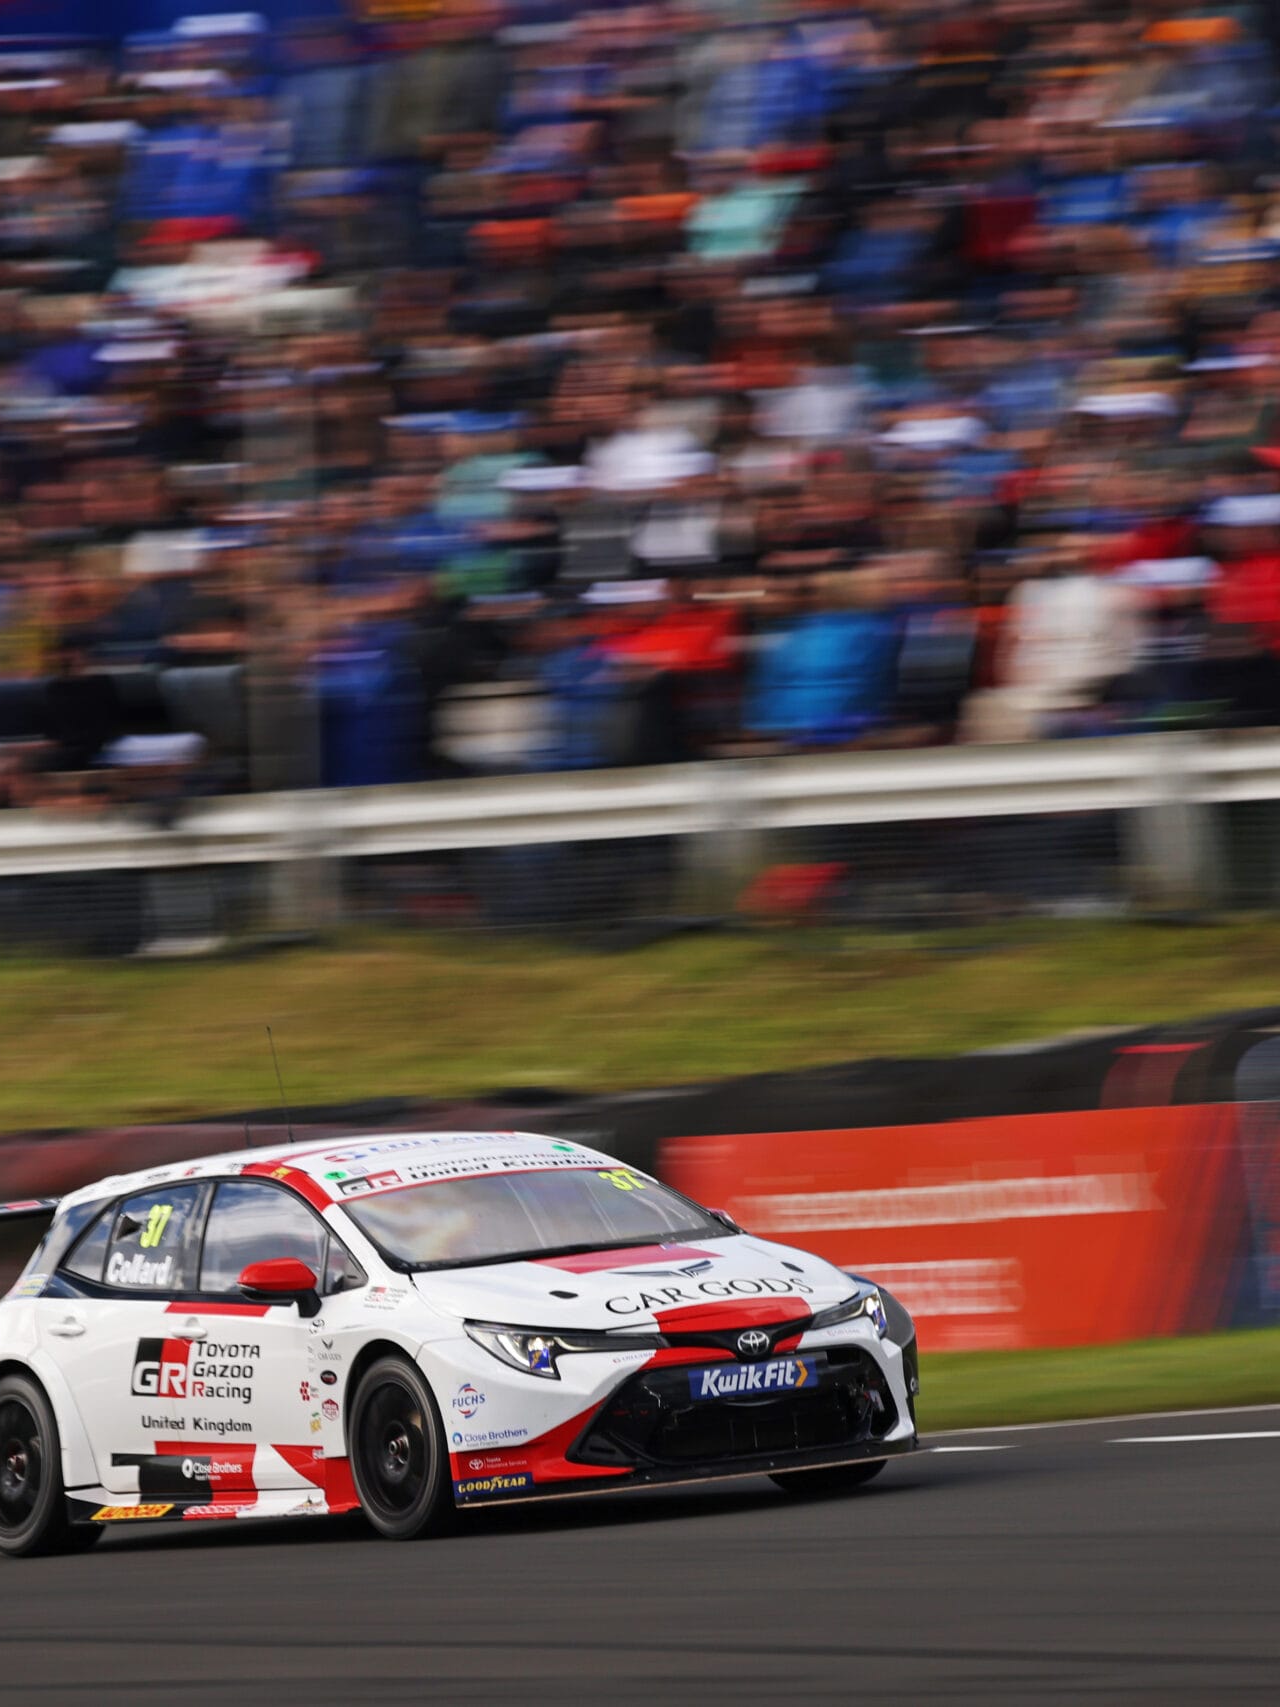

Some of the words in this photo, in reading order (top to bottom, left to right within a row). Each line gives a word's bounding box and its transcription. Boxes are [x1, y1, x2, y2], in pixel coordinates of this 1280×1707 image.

[410, 1162, 490, 1180] United
[501, 1158, 604, 1168] Kingdom
[597, 1169, 646, 1191] 37
[140, 1204, 174, 1248] 37
[107, 1252, 173, 1285] Collard
[605, 1287, 700, 1315] CAR
[698, 1277, 814, 1297] GODS
[195, 1340, 261, 1358] TOYOTA
[132, 1361, 186, 1396] GR
[192, 1361, 254, 1379] GAZOO
[192, 1381, 252, 1404] Racing
[452, 1393, 486, 1409] FUCHS
[141, 1415, 186, 1430] United
[192, 1417, 253, 1436] Kingdom
[464, 1433, 488, 1443] Close
[488, 1428, 528, 1440] Brothers
[193, 1462, 211, 1474] Close
[212, 1462, 243, 1474] Brothers
[458, 1476, 527, 1494] GOODYEAR
